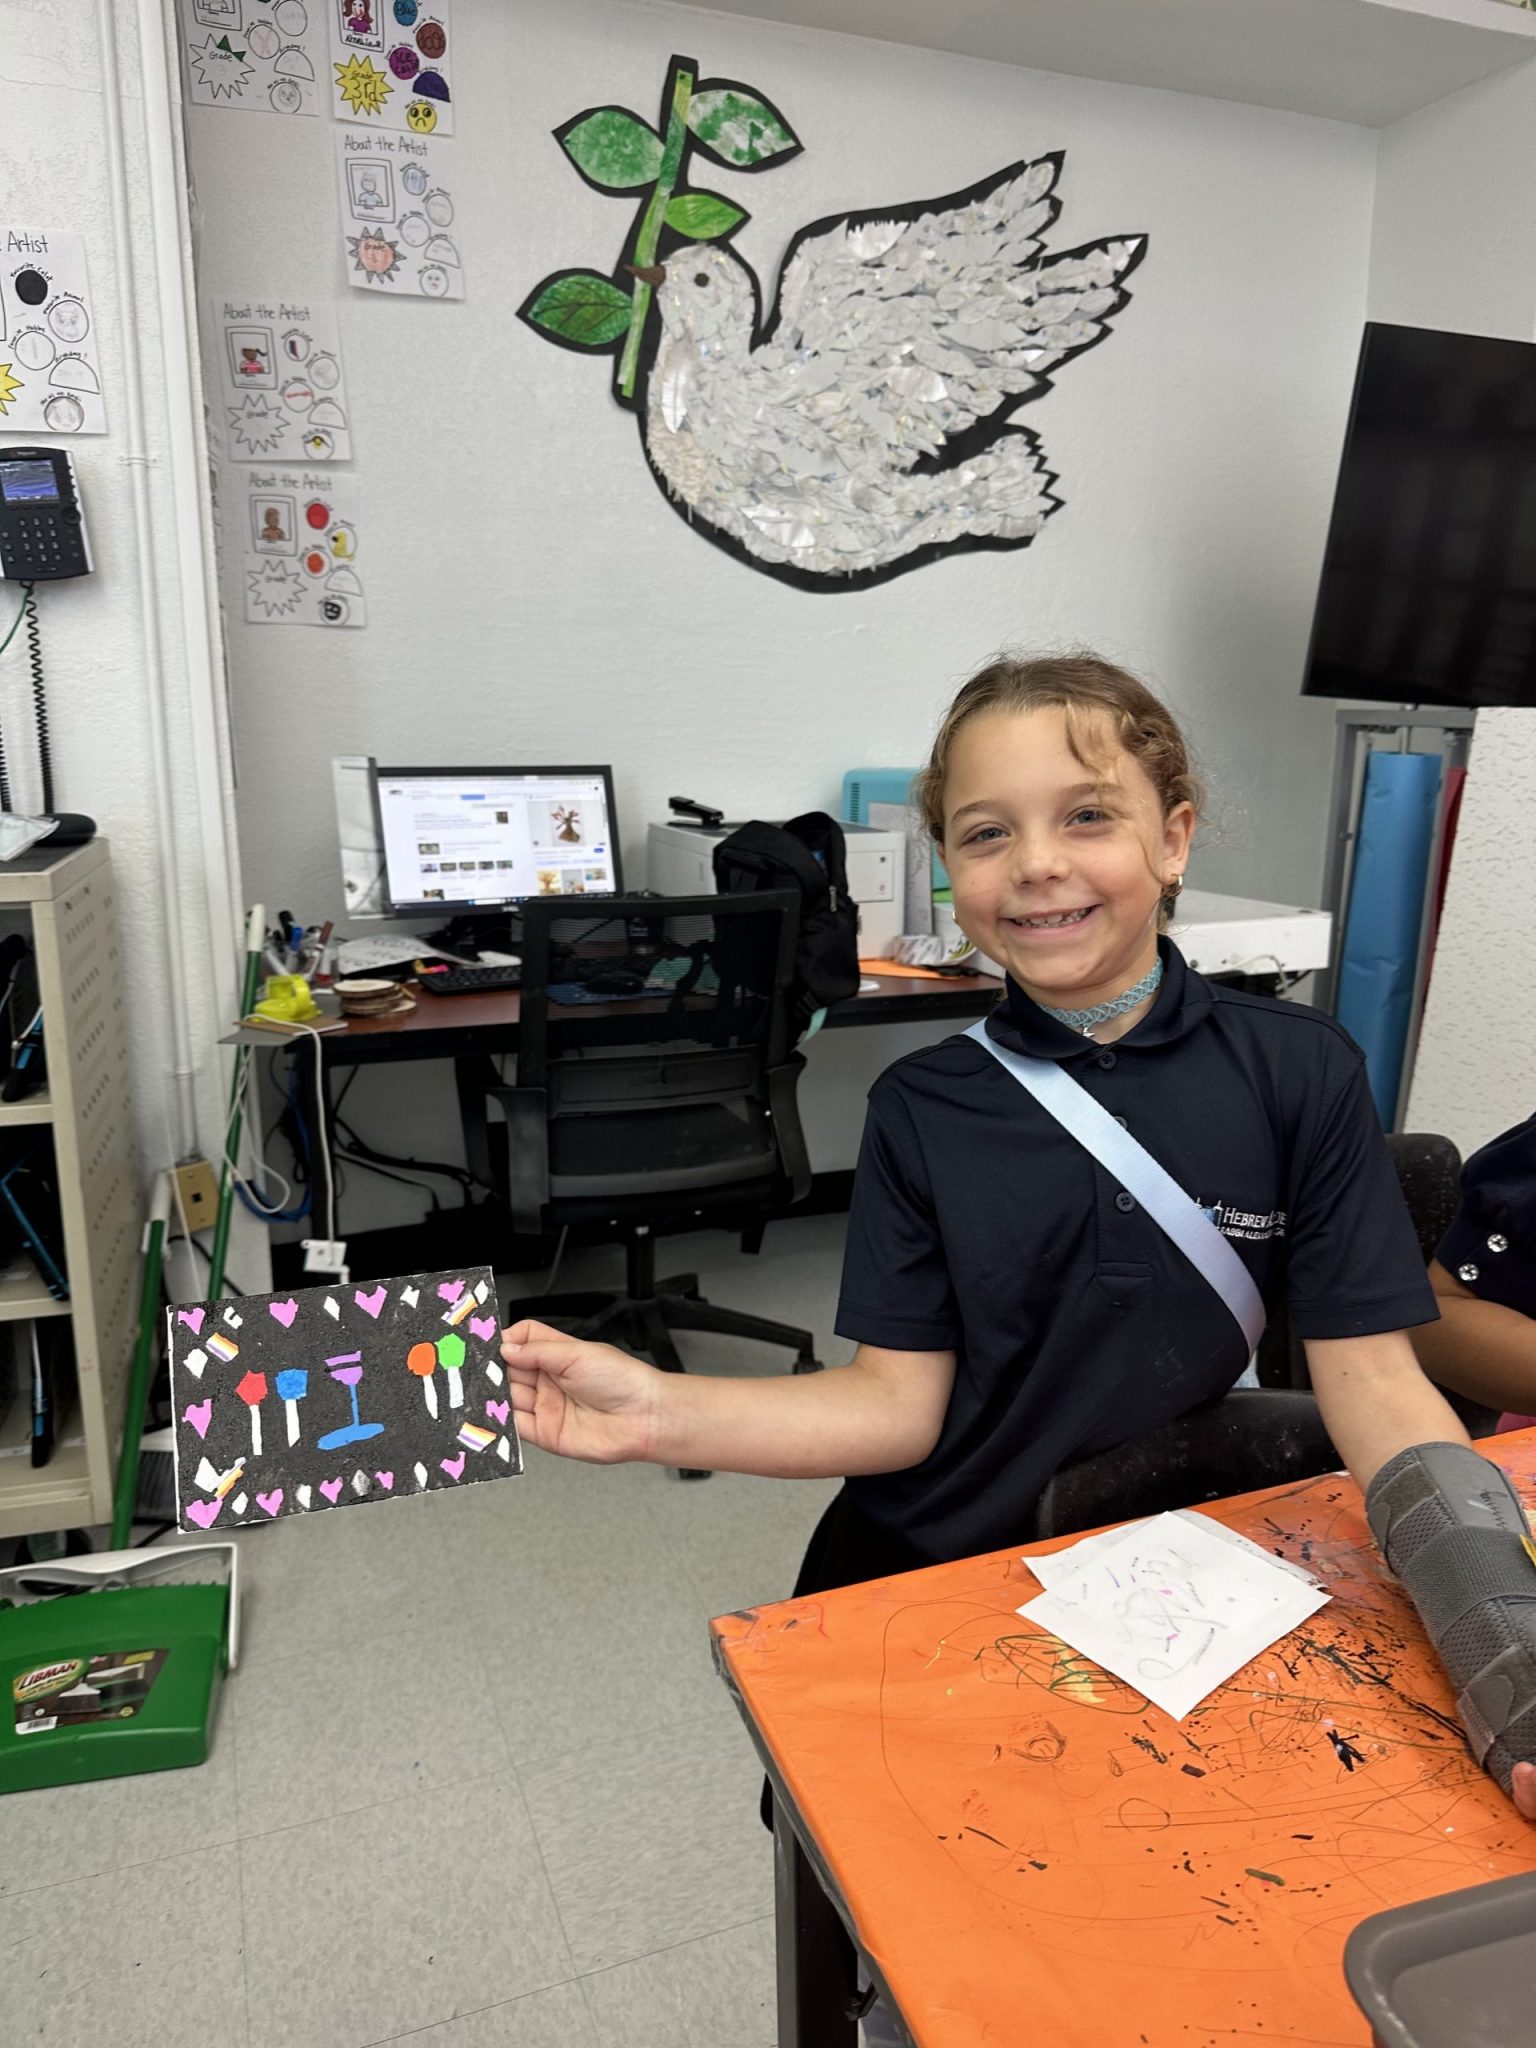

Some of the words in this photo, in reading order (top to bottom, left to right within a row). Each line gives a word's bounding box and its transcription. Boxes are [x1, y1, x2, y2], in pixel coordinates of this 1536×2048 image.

[352, 79, 377, 102] 3rd
[344, 134, 372, 151] About
[375, 135, 395, 152] the
[398, 135, 428, 156] Artist
[8, 231, 48, 253] Artist
[224, 303, 251, 320] About
[256, 304, 275, 320] the
[279, 303, 311, 321] Artist
[250, 472, 276, 488] About
[281, 473, 300, 489] the
[18, 1662, 78, 1690] LIBMAN
